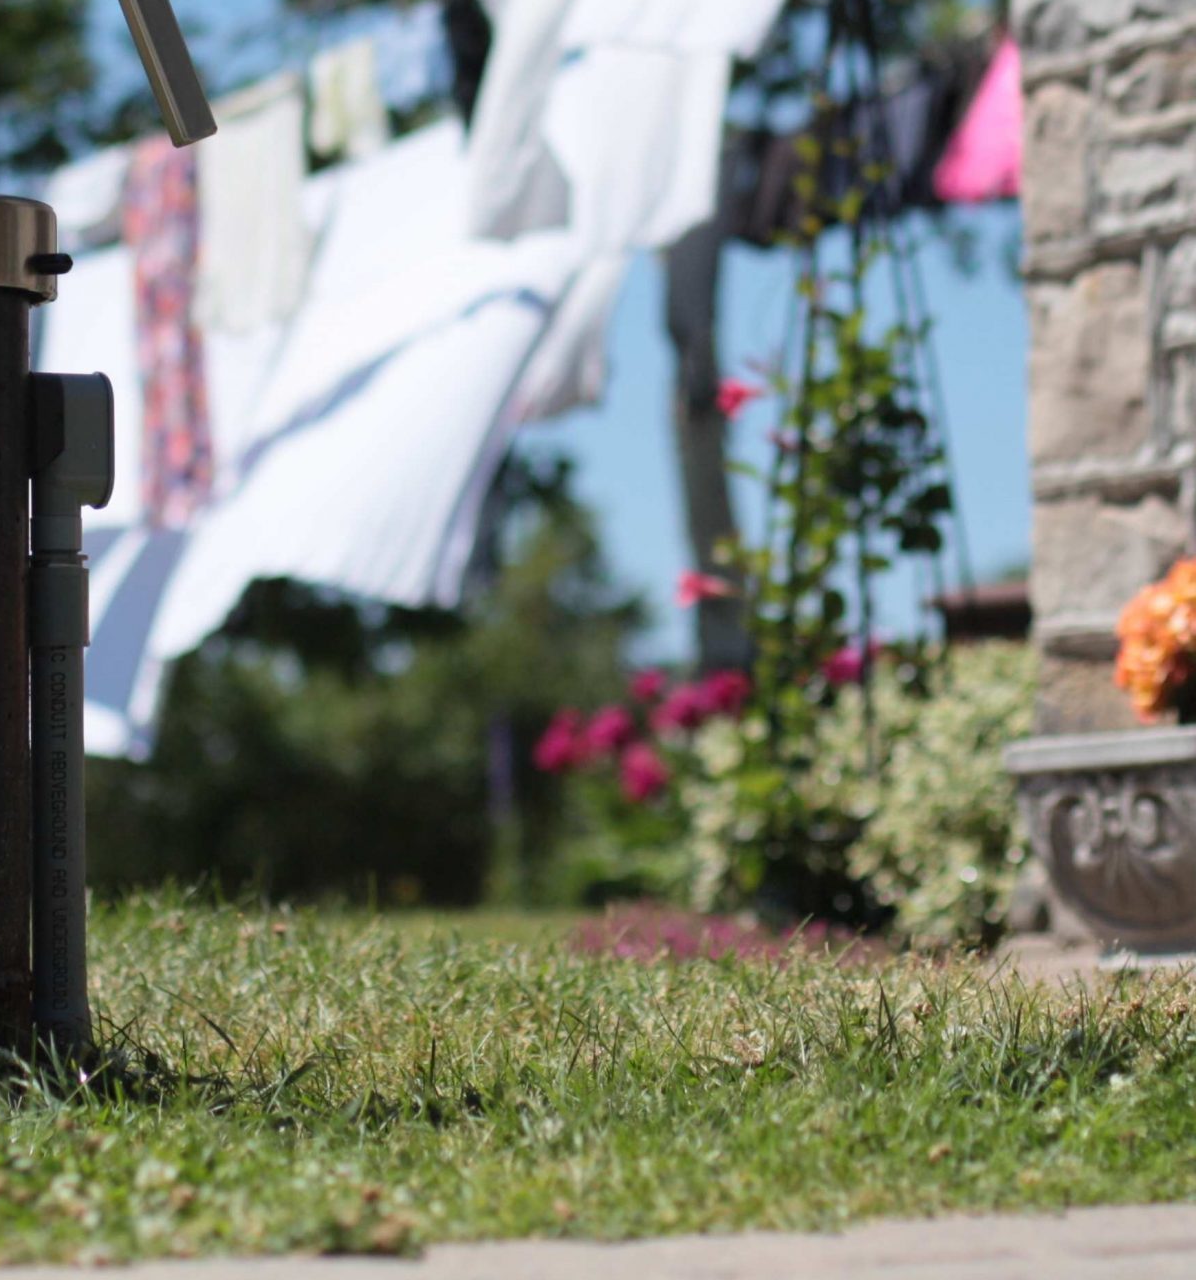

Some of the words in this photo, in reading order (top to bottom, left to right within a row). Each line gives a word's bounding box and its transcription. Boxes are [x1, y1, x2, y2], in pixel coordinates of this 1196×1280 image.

[51, 672, 66, 740] CONDUIT
[51, 751, 68, 859] ABOVEGROUND
[52, 869, 68, 897] AND
[52, 908, 69, 1010] UNDERGROUND
